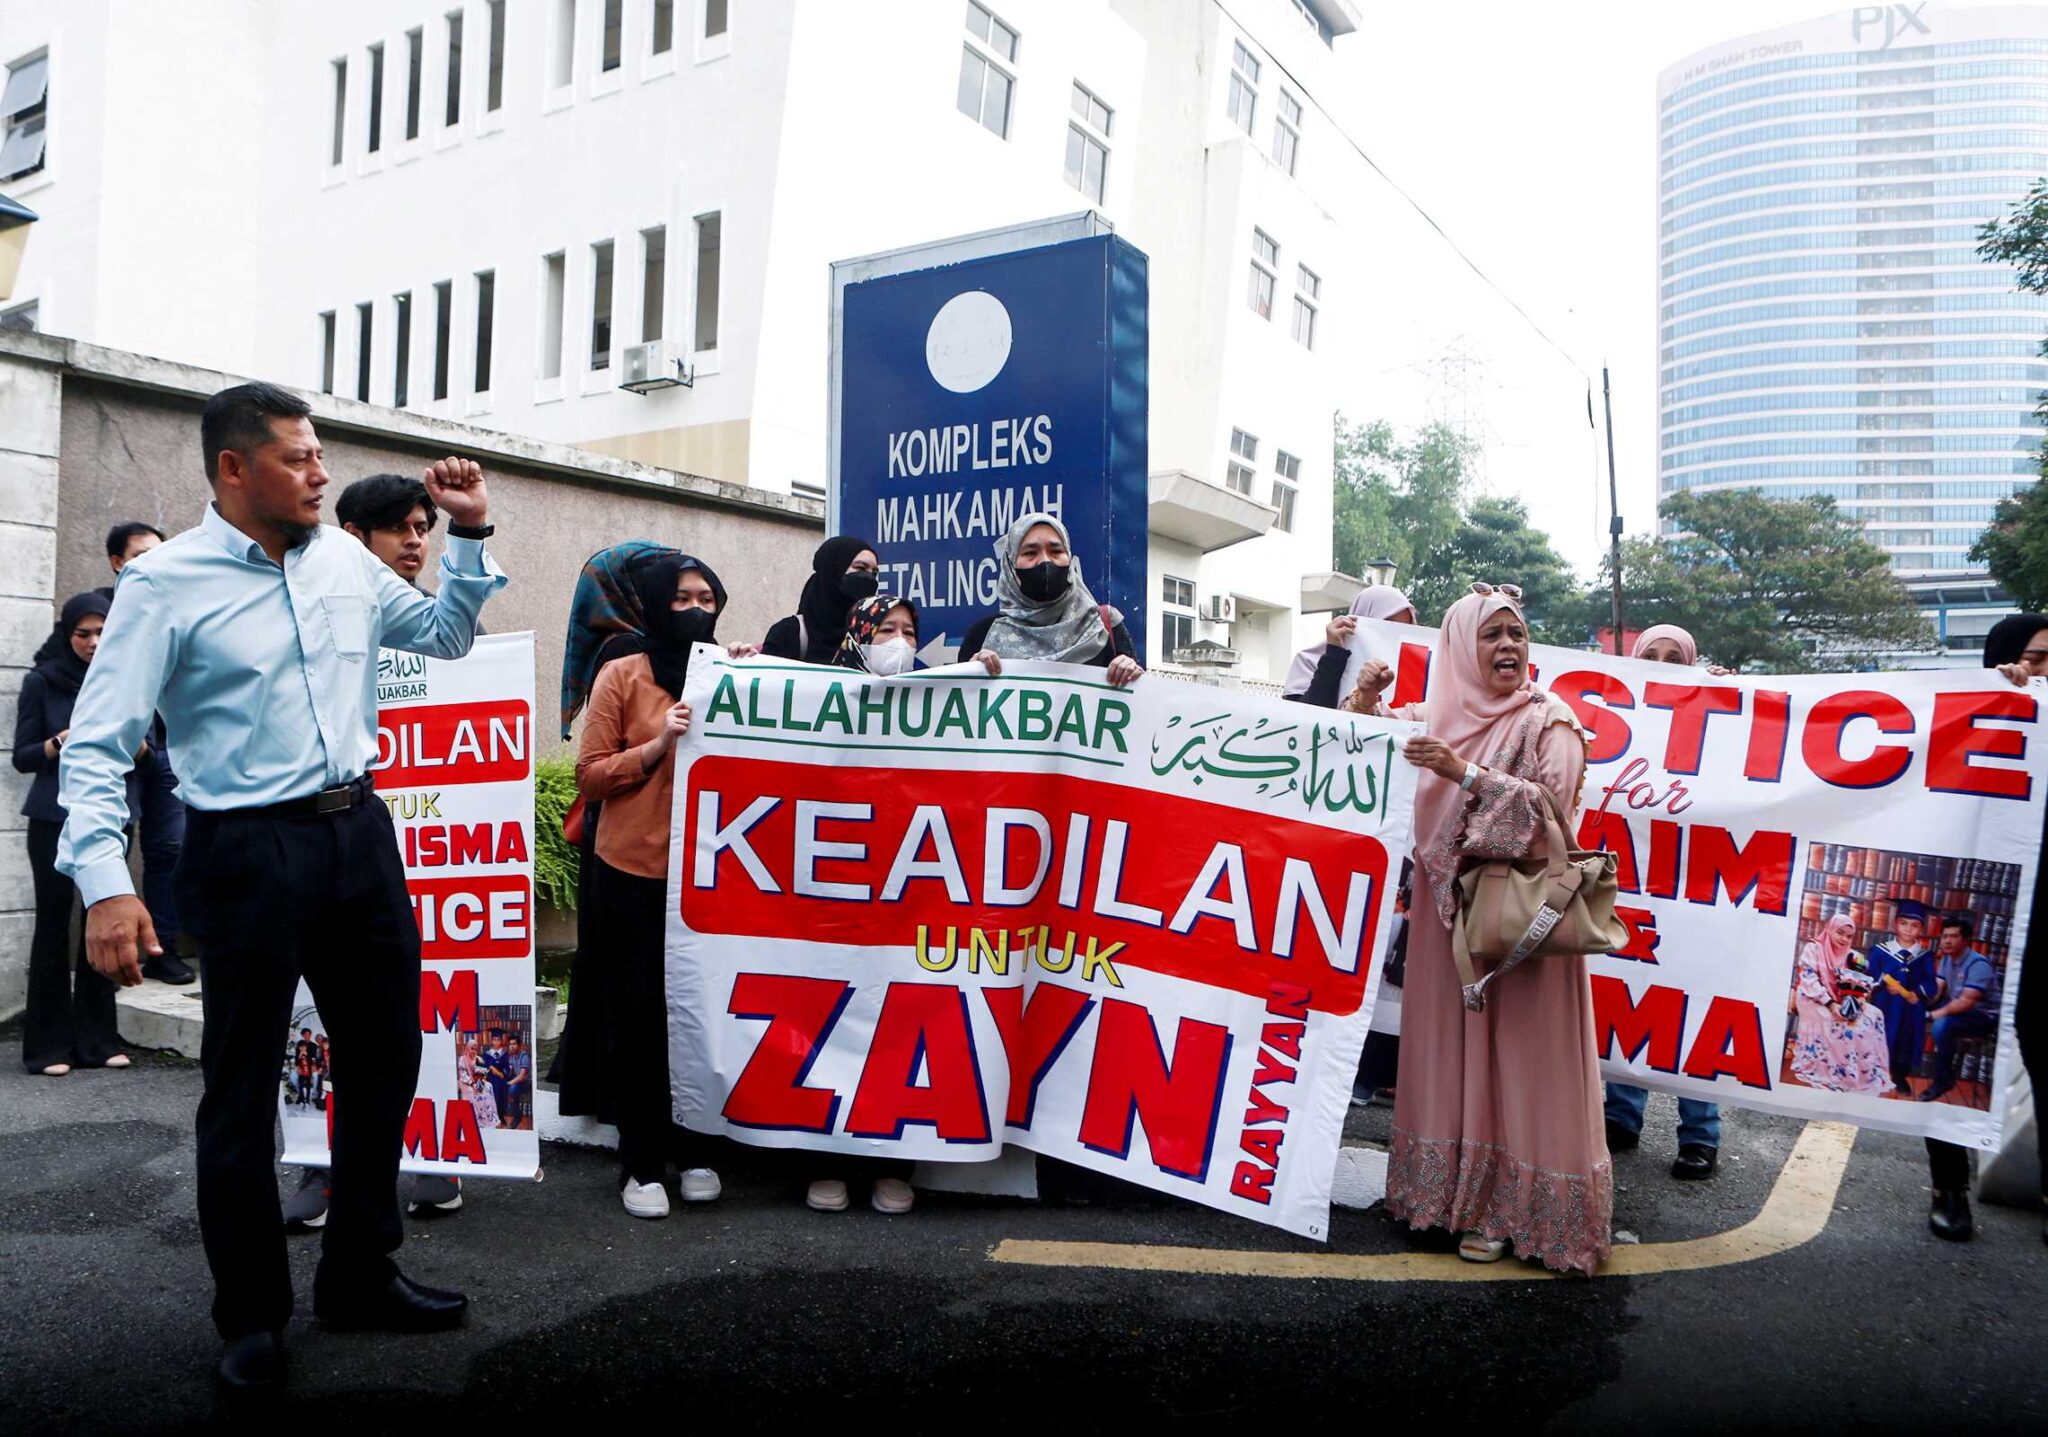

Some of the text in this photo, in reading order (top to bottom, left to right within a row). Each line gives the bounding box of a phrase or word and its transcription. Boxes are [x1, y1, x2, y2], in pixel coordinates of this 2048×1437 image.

[1749, 40, 1803, 59] TOWER
[1852, 1, 1931, 50] PJX
[888, 414, 1053, 478] KOMPLEKS
[877, 484, 1063, 543] MAHKAMAH
[877, 557, 997, 608] ETALING
[369, 715, 526, 771] DILAN
[704, 673, 1132, 754] ALLAHUAKBAR
[1388, 641, 2038, 801] JSTICE
[1593, 757, 1694, 826] for
[404, 821, 528, 868] ISMA
[693, 790, 1372, 975] KEADILAN
[1529, 907, 1557, 940] GUES
[915, 923, 1128, 989] UNTUK
[721, 972, 1234, 1185] ZAYN
[1230, 977, 1312, 1205] RAYYAN
